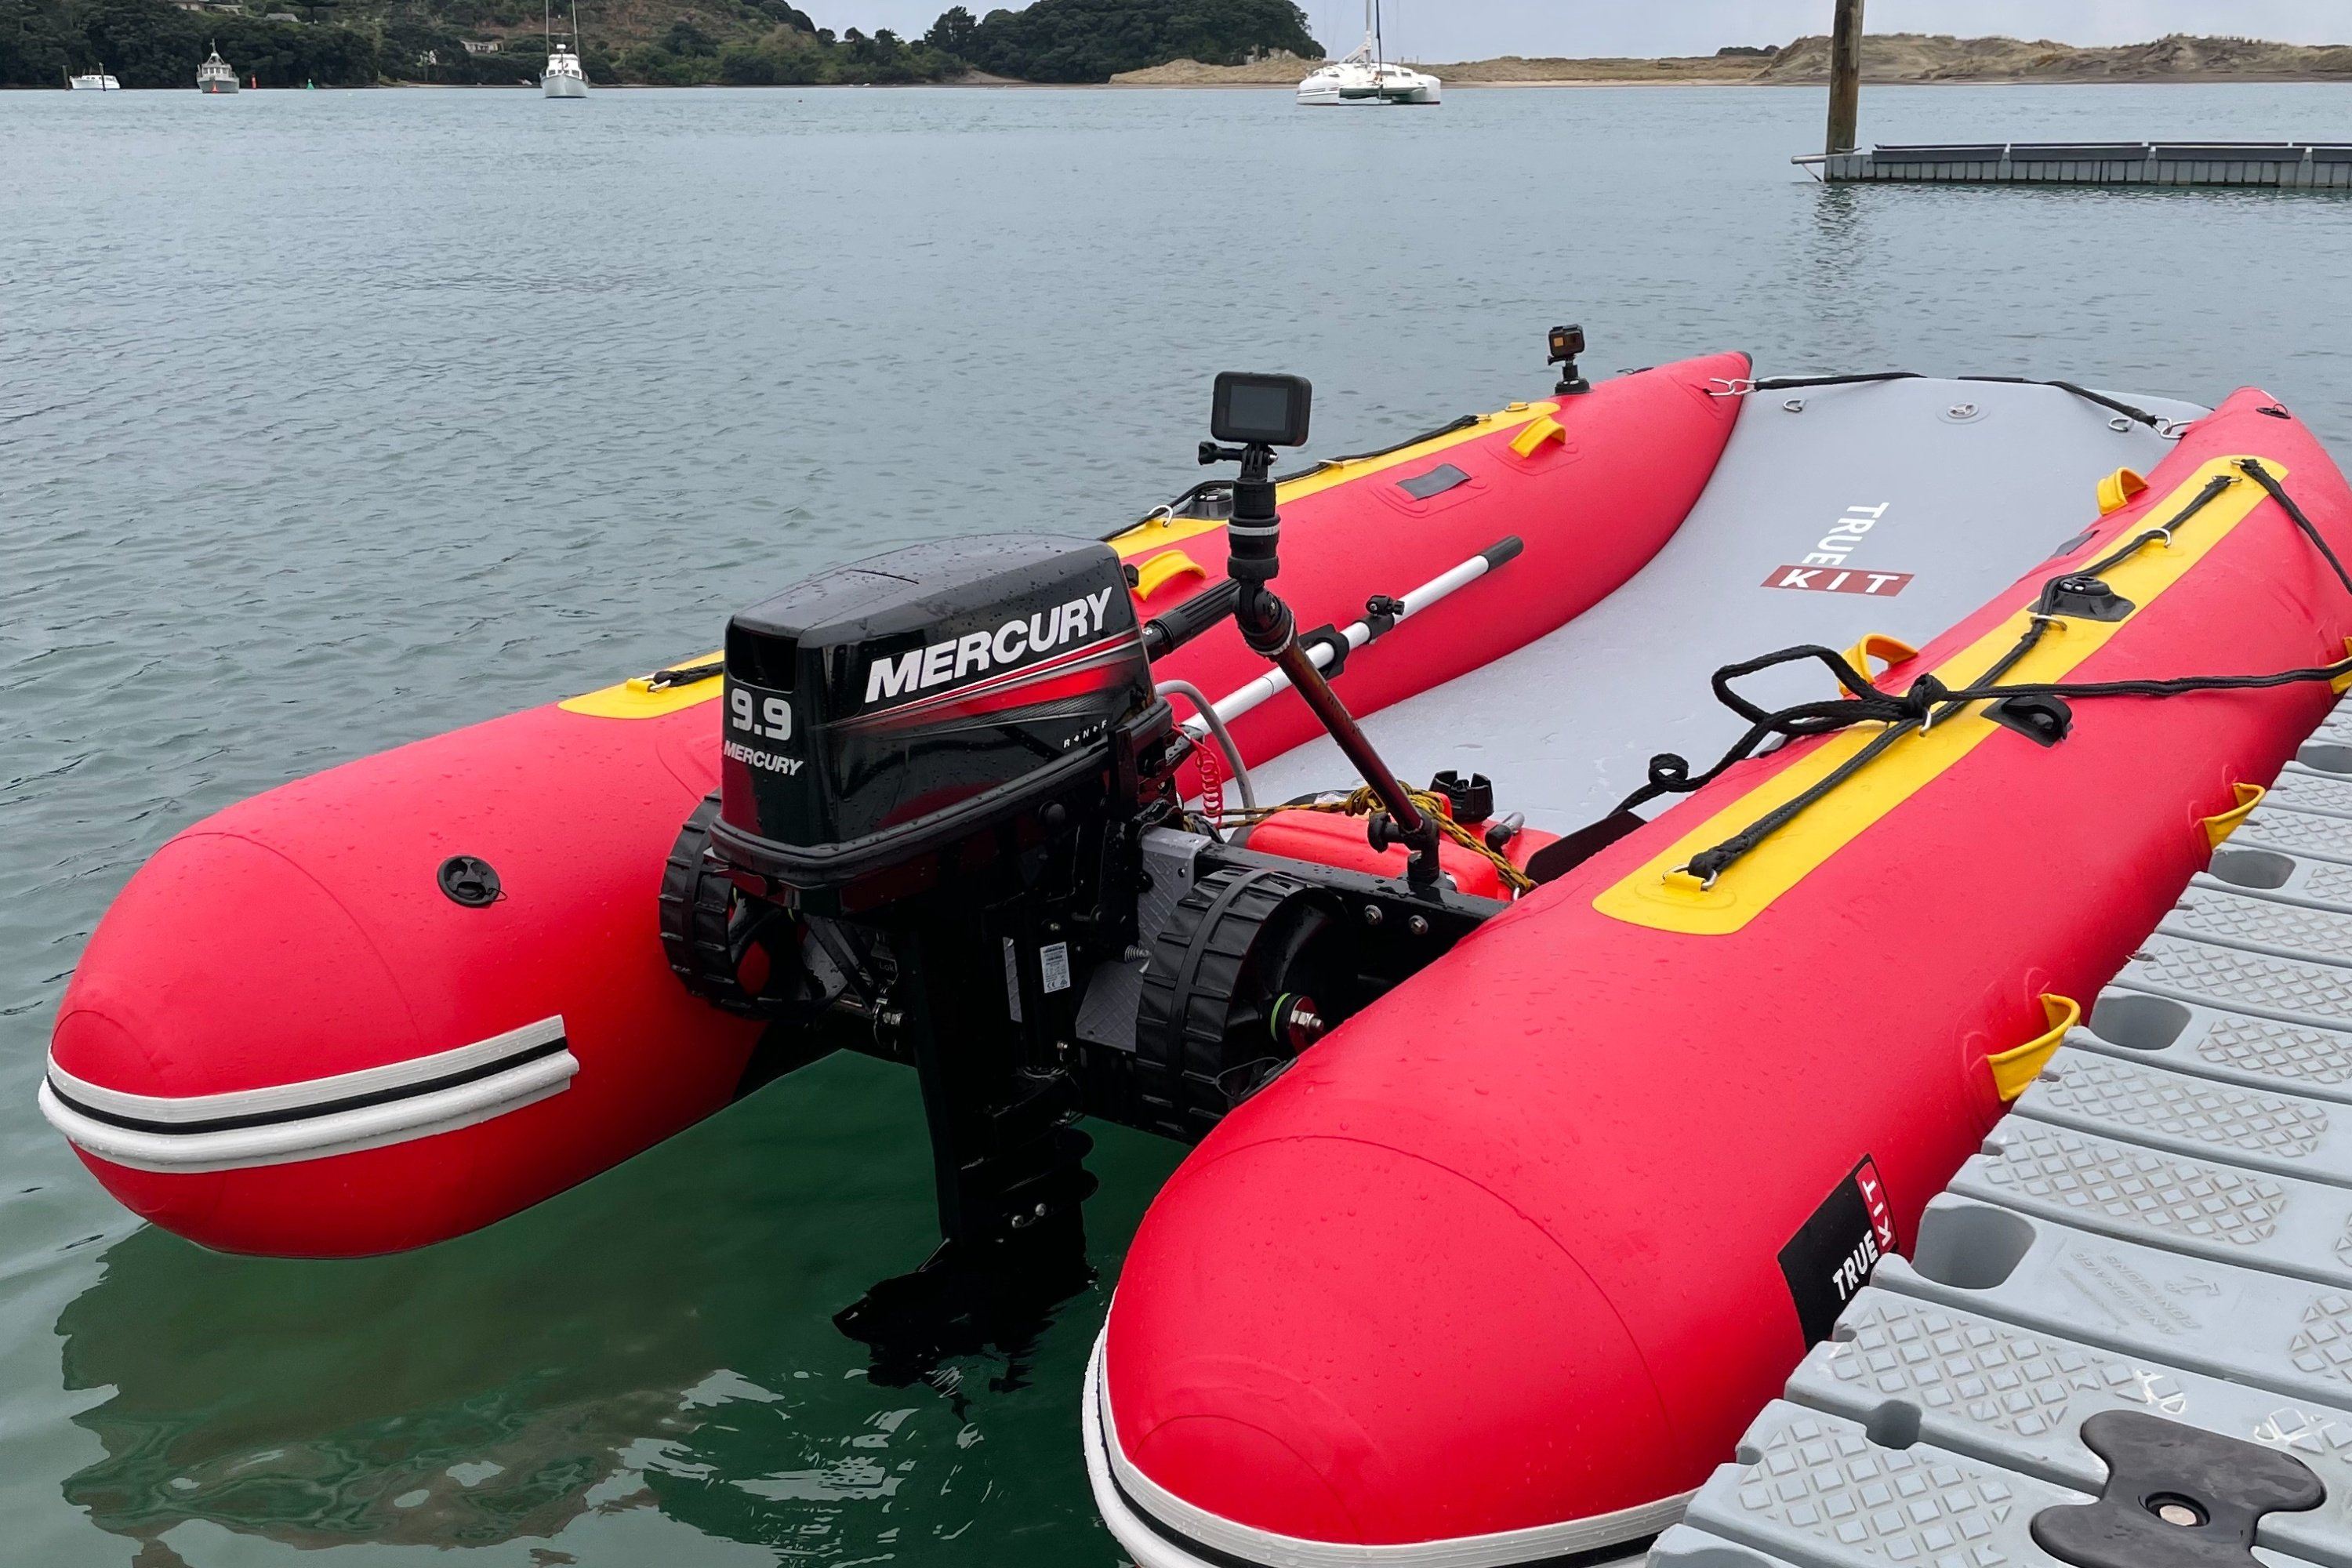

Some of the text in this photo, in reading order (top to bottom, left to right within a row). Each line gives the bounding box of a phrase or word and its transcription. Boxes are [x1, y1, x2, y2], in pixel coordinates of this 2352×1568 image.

[1802, 502, 1889, 565] TRUE
[1778, 568, 1900, 593] KIT
[865, 586, 1112, 704] MERCURY
[731, 687, 792, 741] 9.9
[1083, 728, 1089, 739] N
[1102, 720, 1107, 729] F
[723, 739, 804, 776] MERCURY
[1862, 1179, 1892, 1247] KIT
[1832, 1229, 1878, 1301] TRUE
